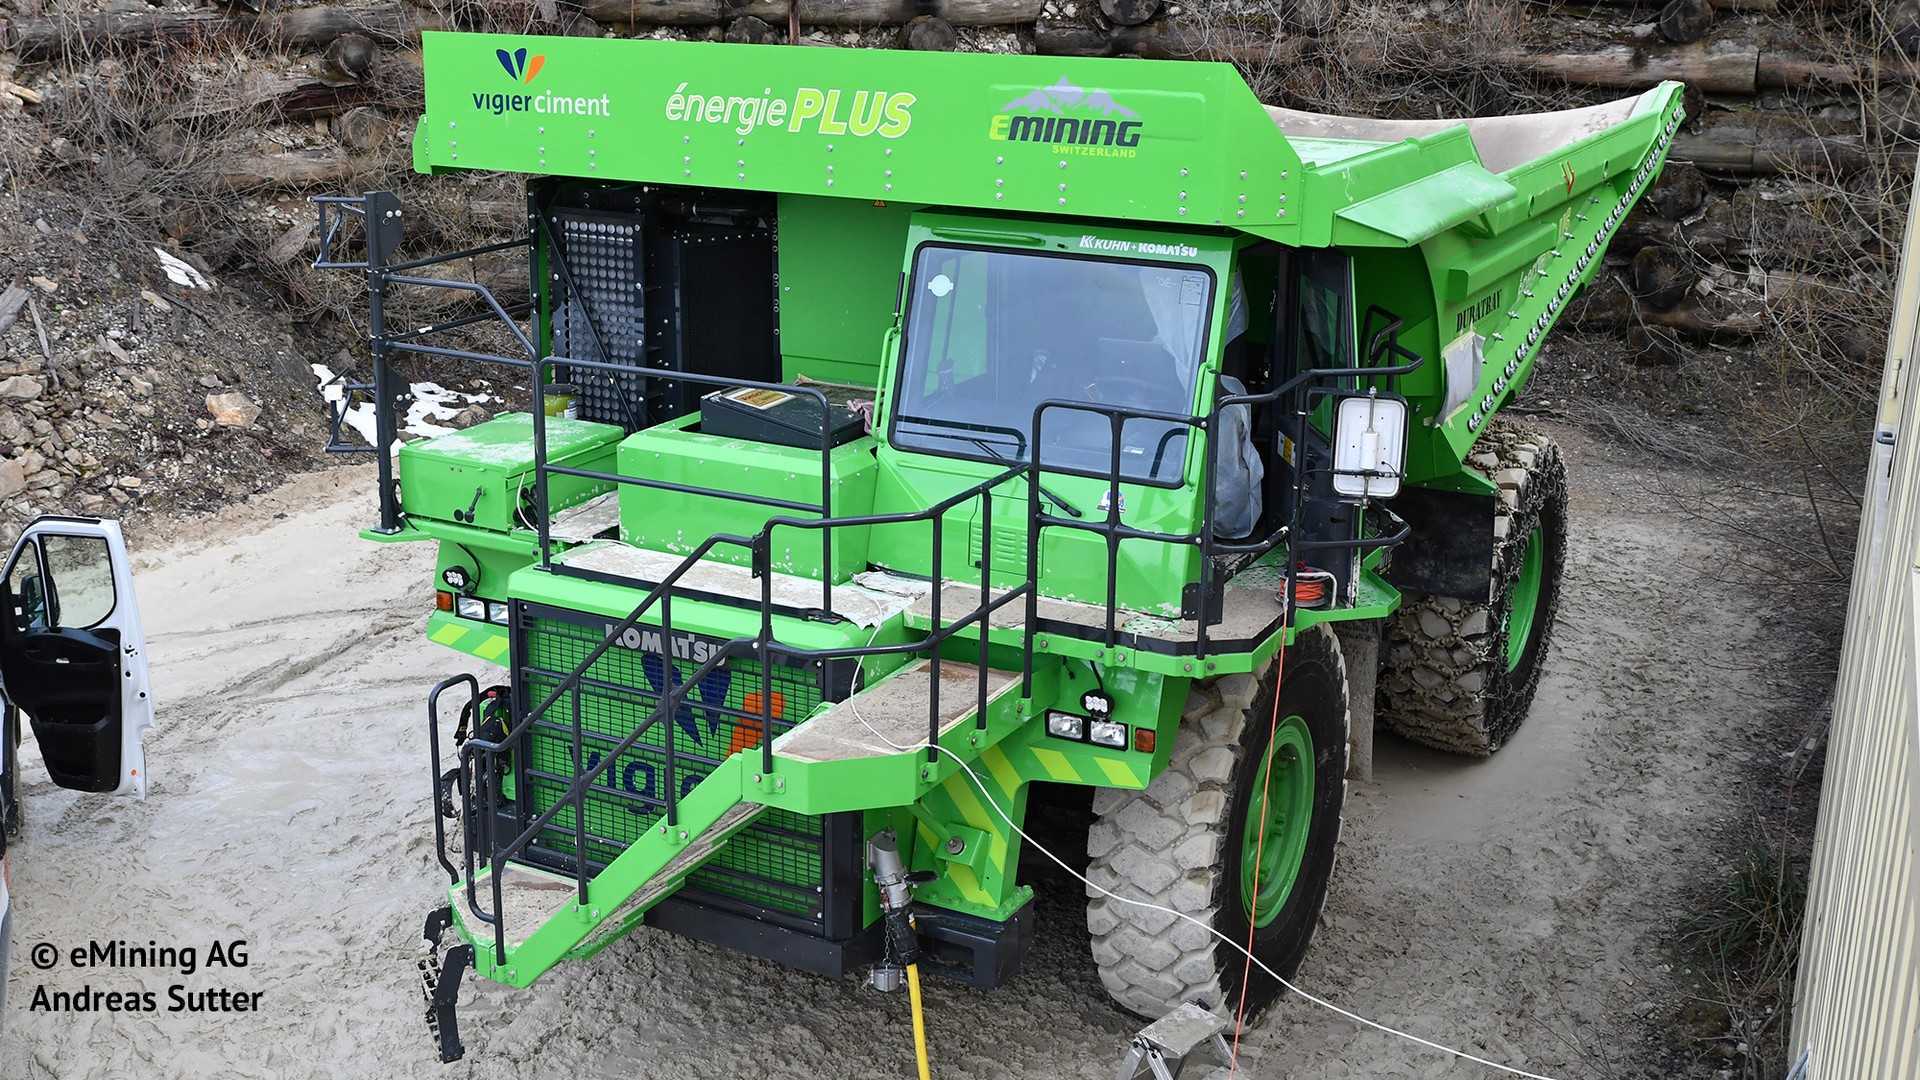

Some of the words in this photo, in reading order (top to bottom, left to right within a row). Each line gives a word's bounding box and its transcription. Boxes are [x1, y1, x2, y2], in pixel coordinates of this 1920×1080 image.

[534, 89, 610, 117] ciment
[665, 81, 787, 135] énergie
[788, 87, 918, 138] PLUS
[1052, 144, 1136, 159] SWITZERLAND
[1138, 243, 1198, 258] KOMATSU
[1456, 289, 1503, 333] DURATRAY
